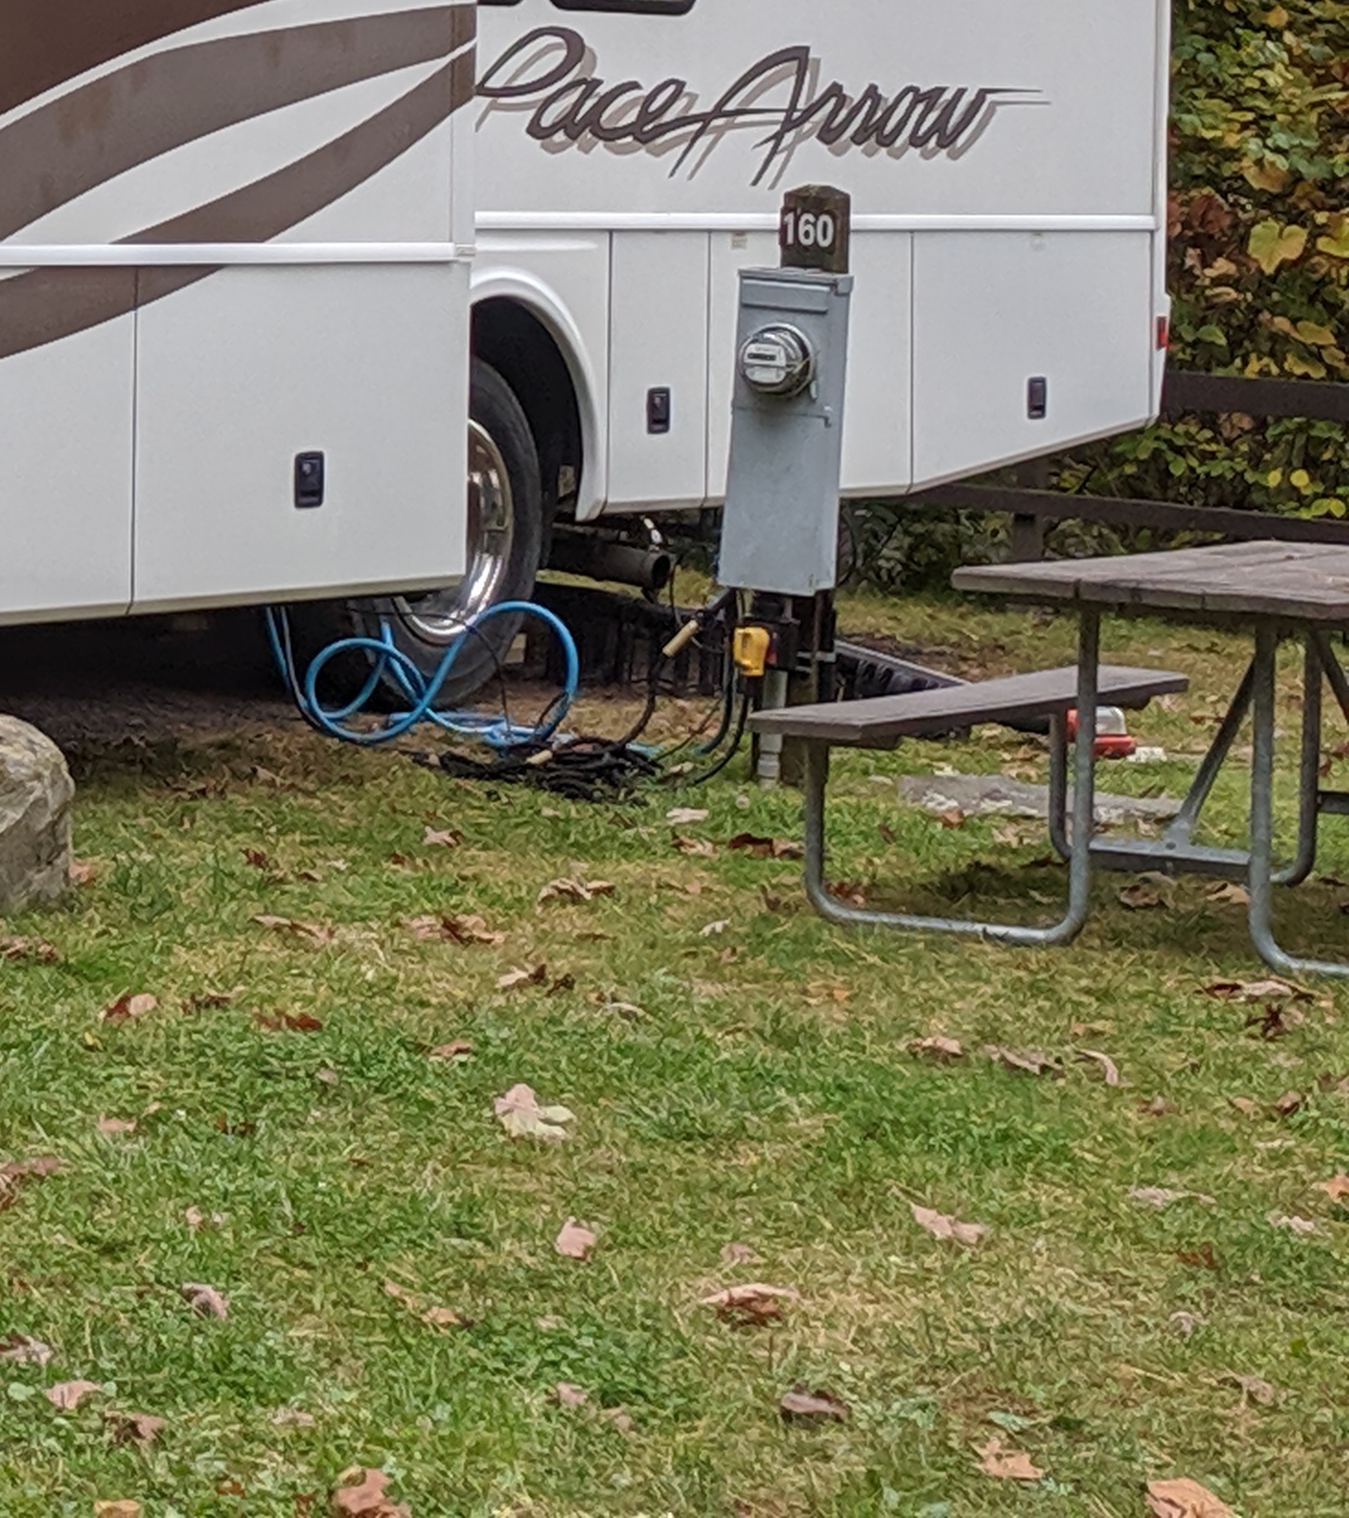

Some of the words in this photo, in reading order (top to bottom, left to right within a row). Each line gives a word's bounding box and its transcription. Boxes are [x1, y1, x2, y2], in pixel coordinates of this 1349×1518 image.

[474, 25, 693, 155] Pace
[667, 44, 1051, 190] Arrow
[783, 211, 835, 248] 160
